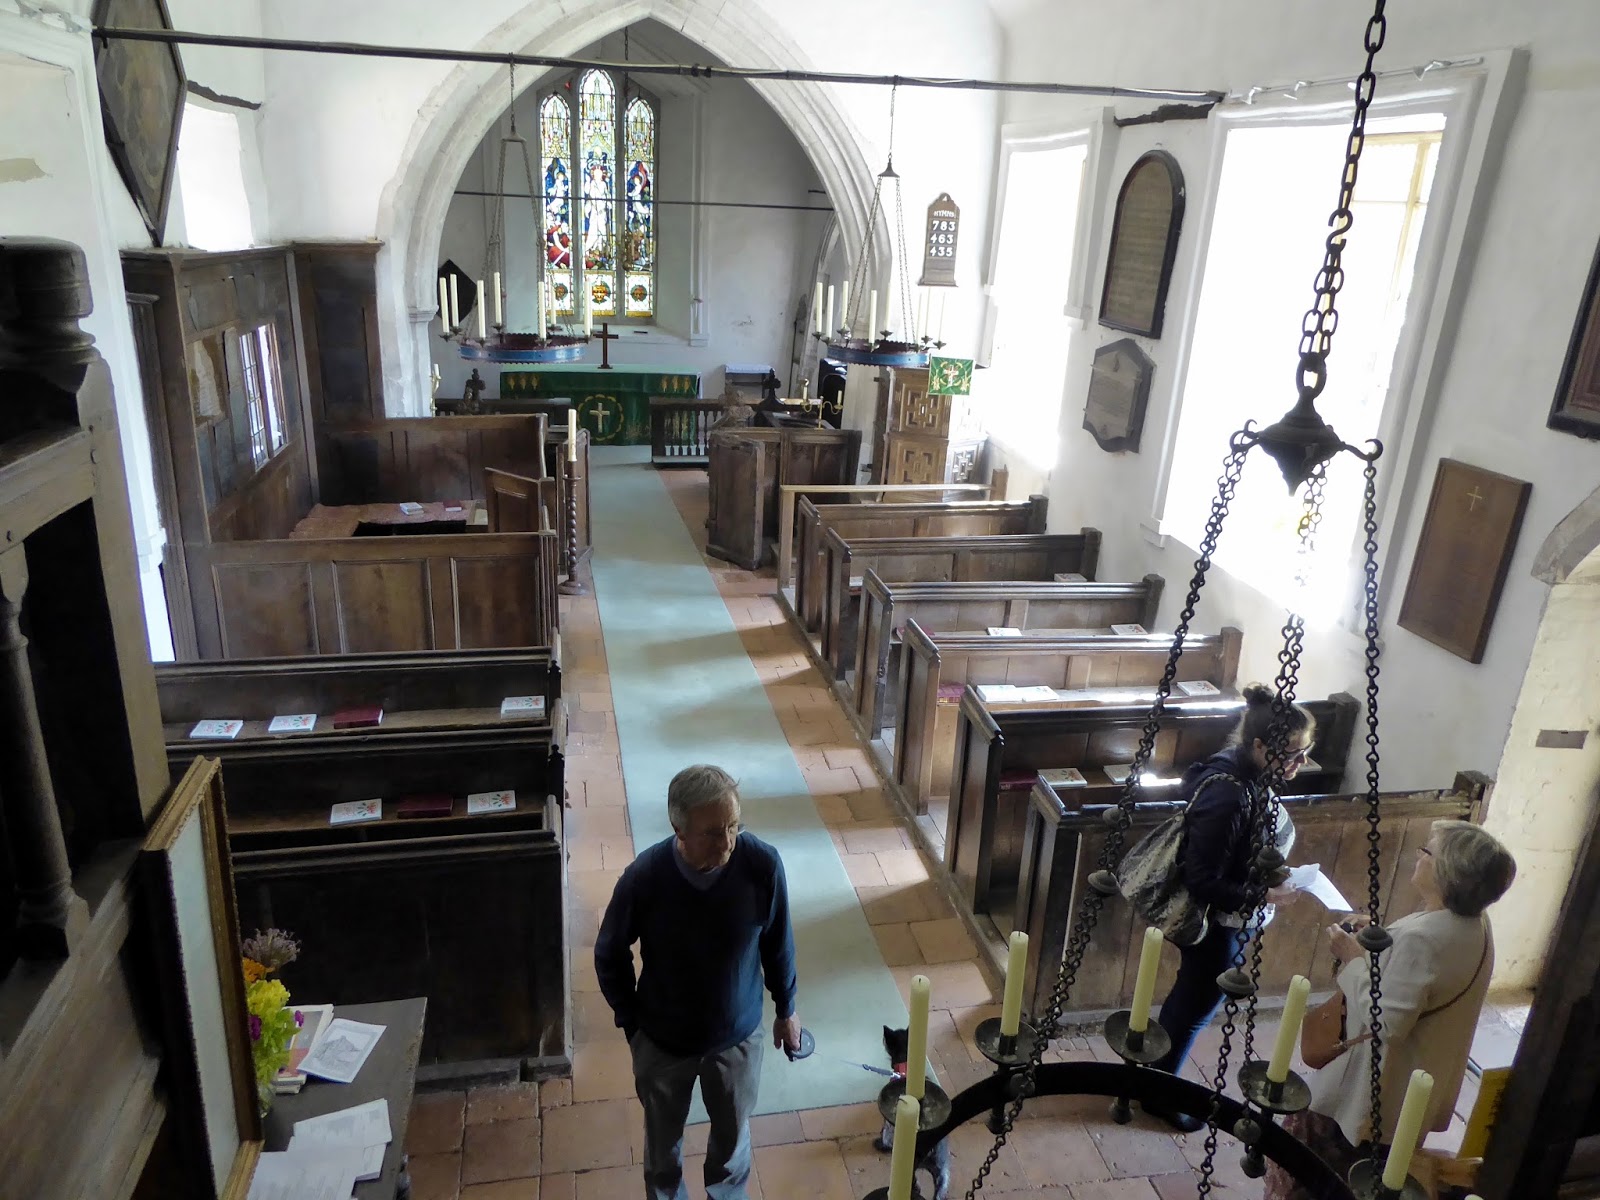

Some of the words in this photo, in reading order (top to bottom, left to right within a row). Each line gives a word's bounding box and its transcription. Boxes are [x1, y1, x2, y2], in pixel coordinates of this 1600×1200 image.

[932, 220, 955, 231] 783
[930, 233, 953, 244] 463
[930, 246, 953, 257] 435
